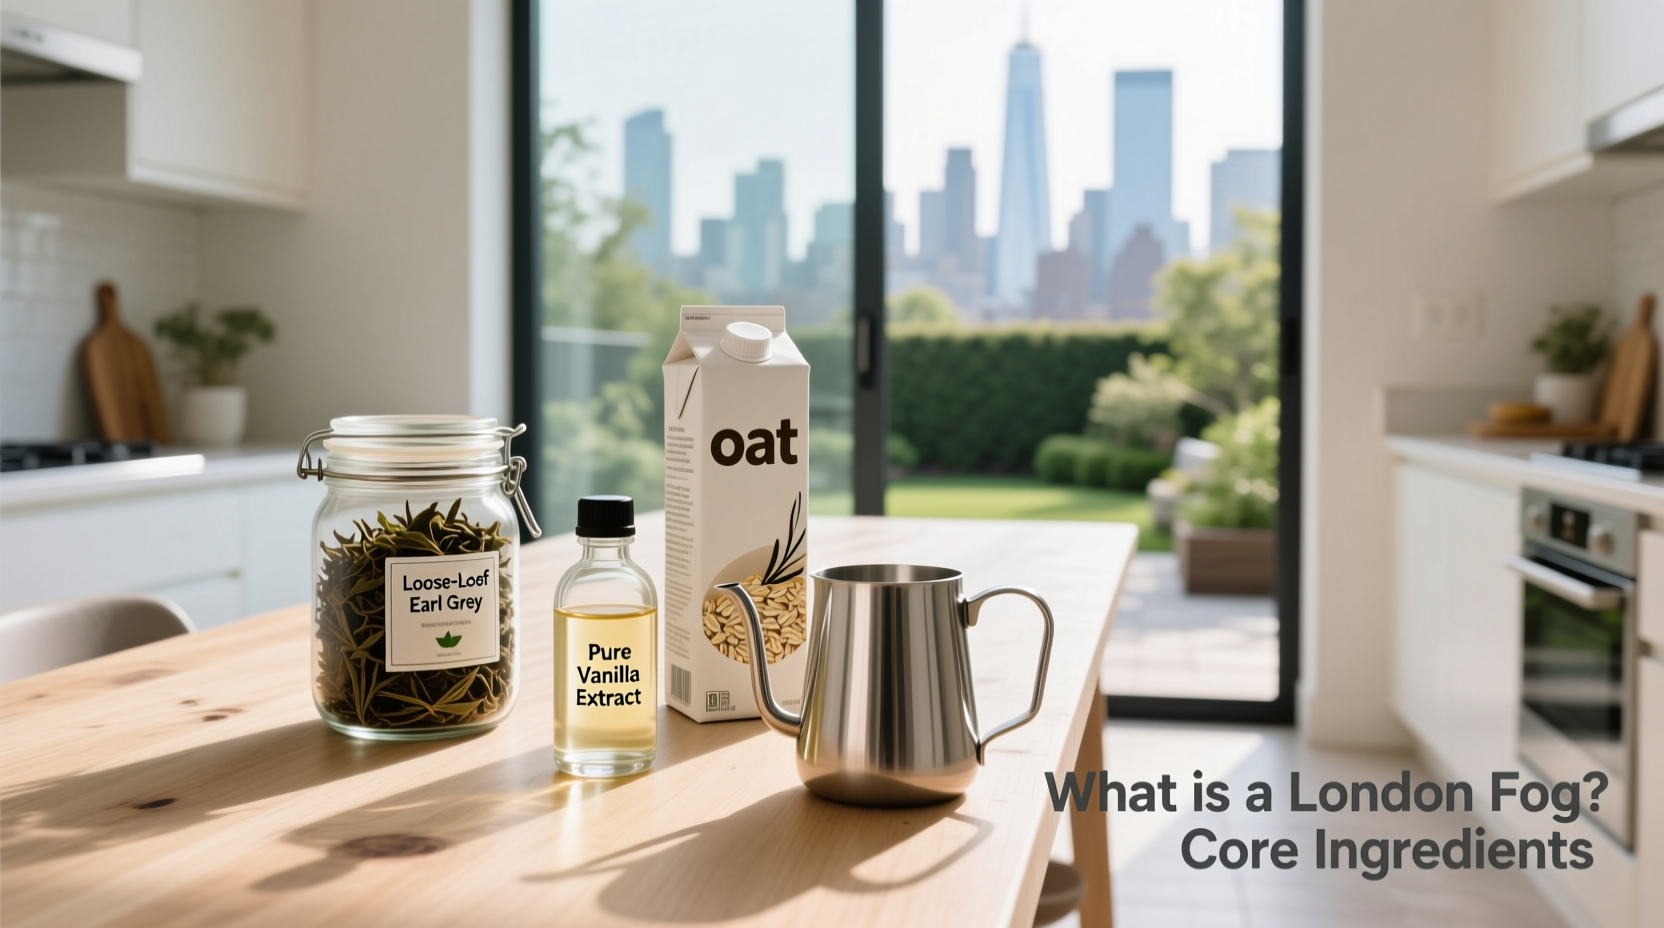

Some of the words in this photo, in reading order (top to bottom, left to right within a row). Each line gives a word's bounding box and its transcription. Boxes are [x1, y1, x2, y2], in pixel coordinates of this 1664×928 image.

[710, 418, 799, 467] oat
[410, 595, 442, 613] Earl
[446, 594, 483, 613] Grey
[588, 643, 632, 661] Pure
[576, 664, 640, 684] Vanilla
[576, 688, 642, 707] Extract
